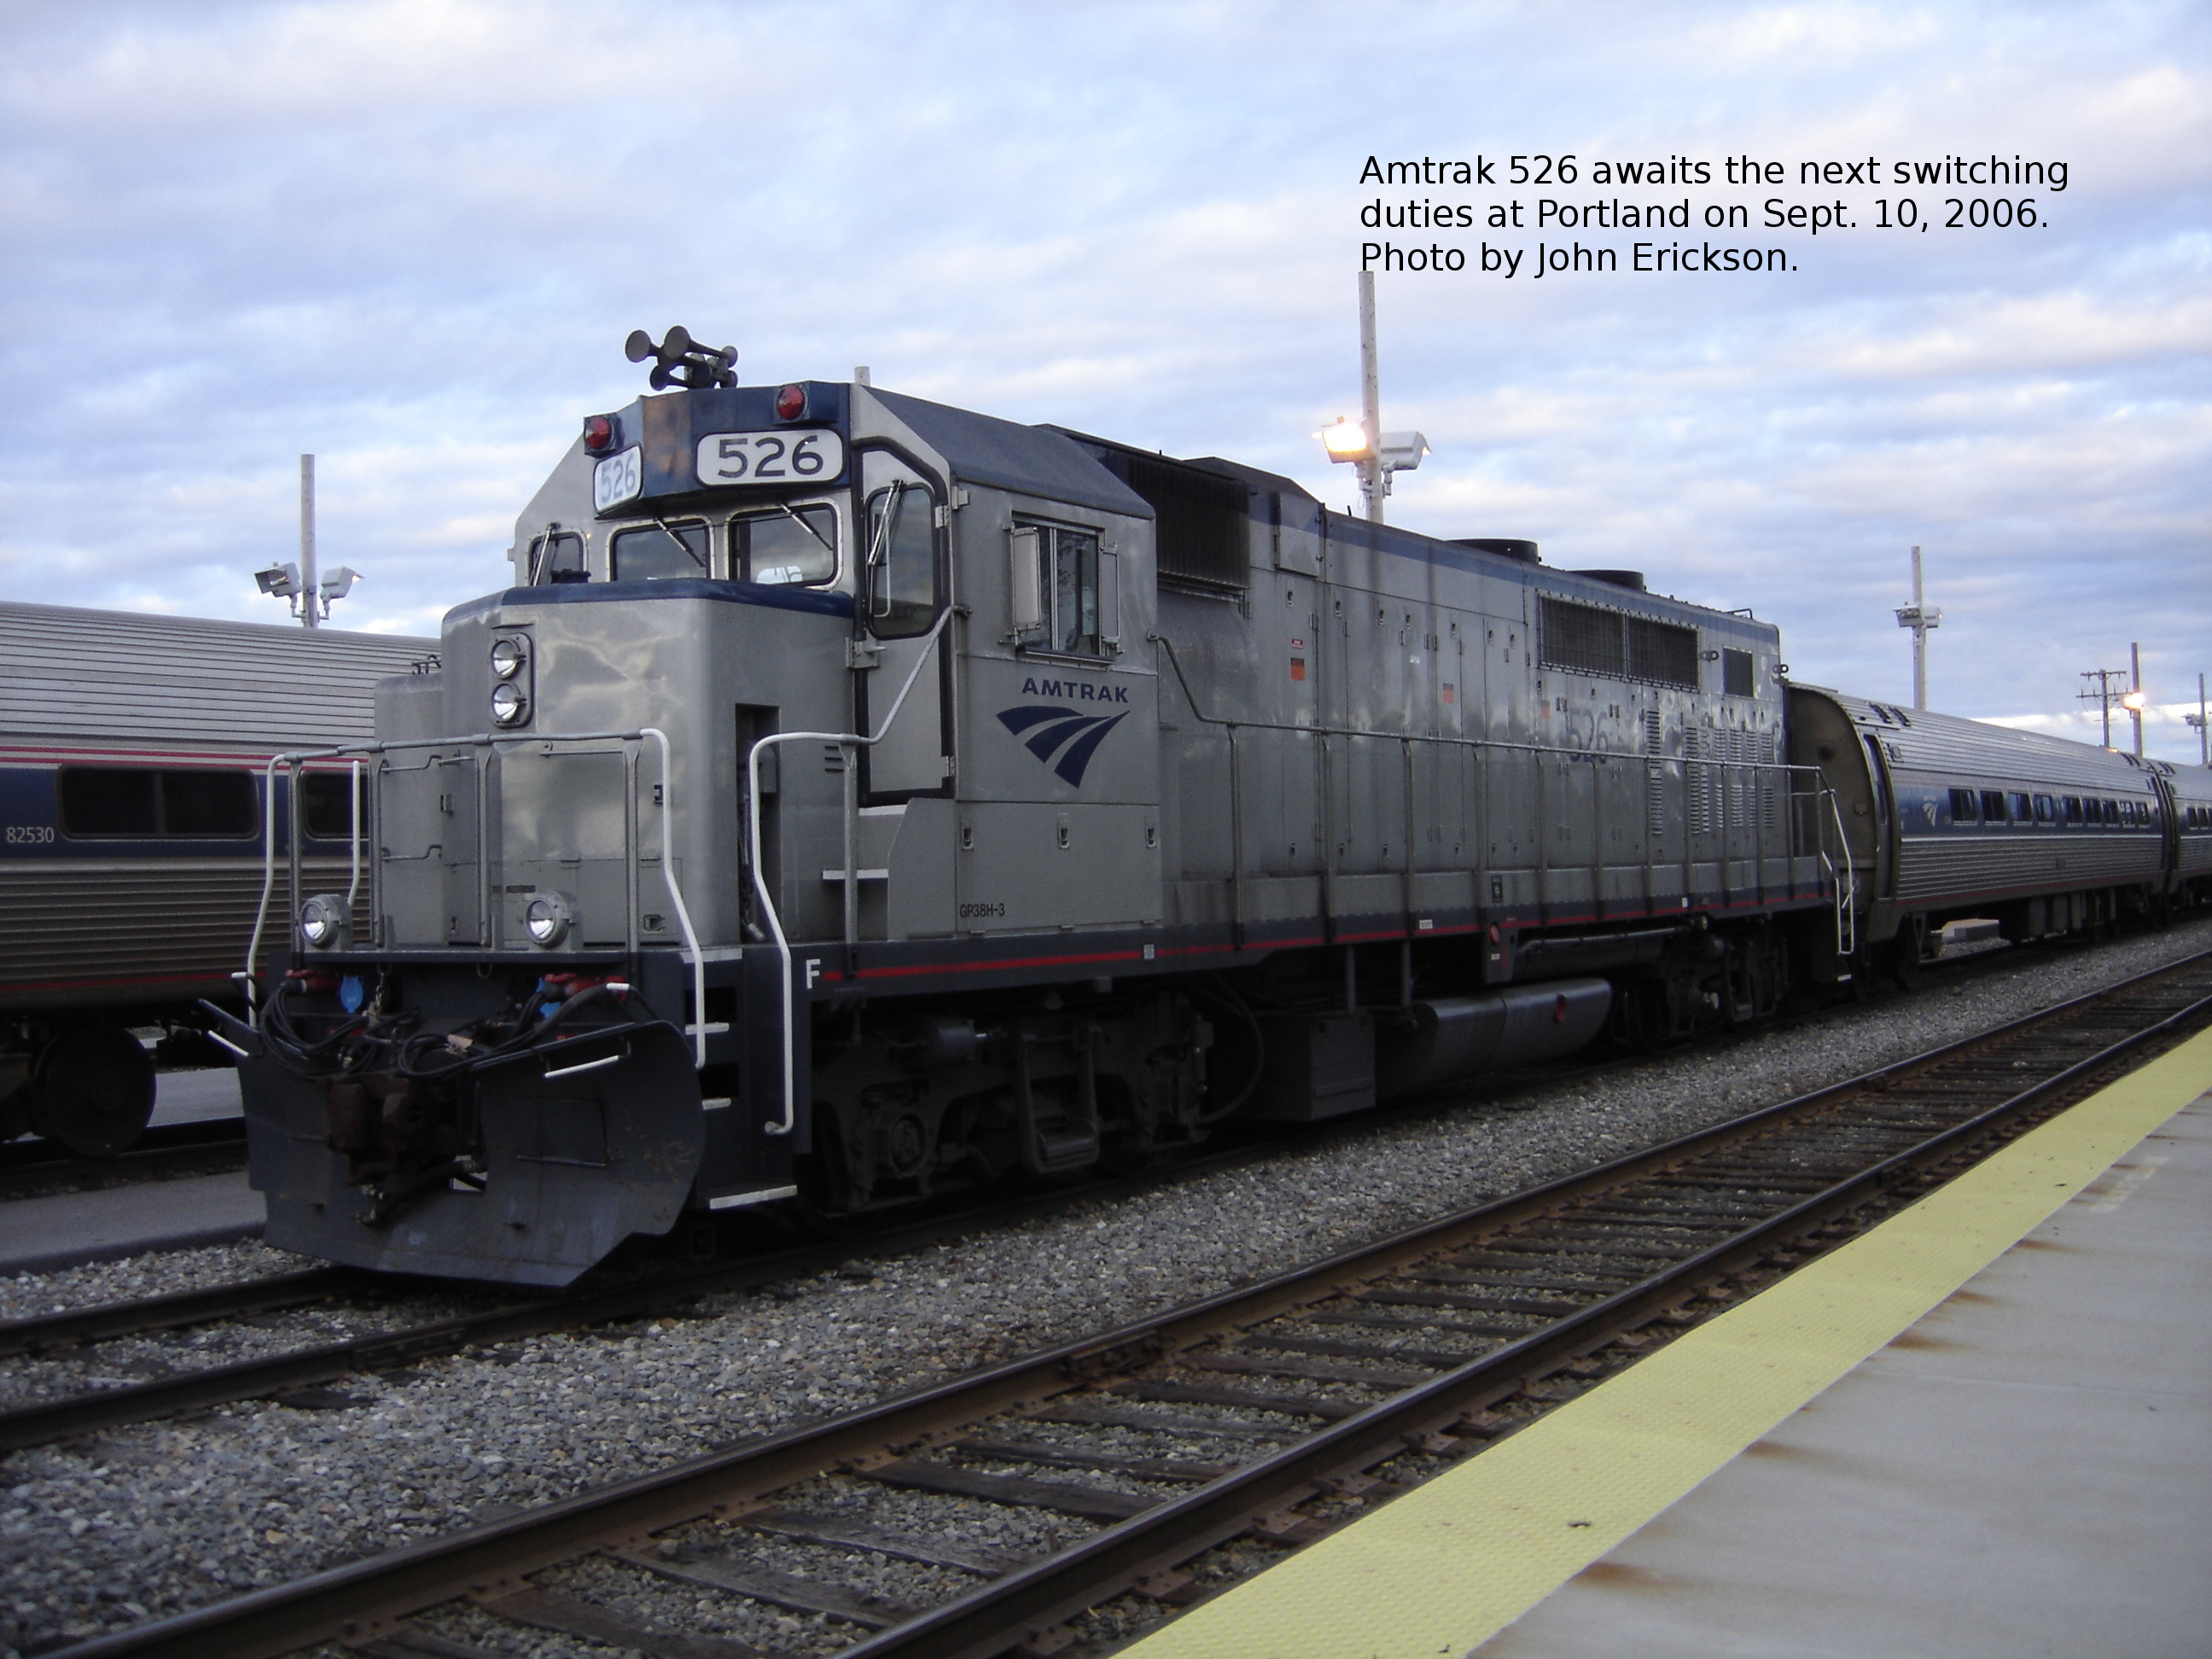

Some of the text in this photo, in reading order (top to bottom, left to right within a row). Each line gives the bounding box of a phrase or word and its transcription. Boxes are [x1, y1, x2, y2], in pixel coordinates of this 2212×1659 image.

[718, 435, 824, 478] 526
[602, 454, 636, 503] 526
[1022, 678, 1128, 703] AMTRAK
[1568, 707, 1608, 765] 526
[6, 827, 55, 844] 82530
[959, 902, 1005, 918] GP38H-3
[806, 958, 821, 989] F
